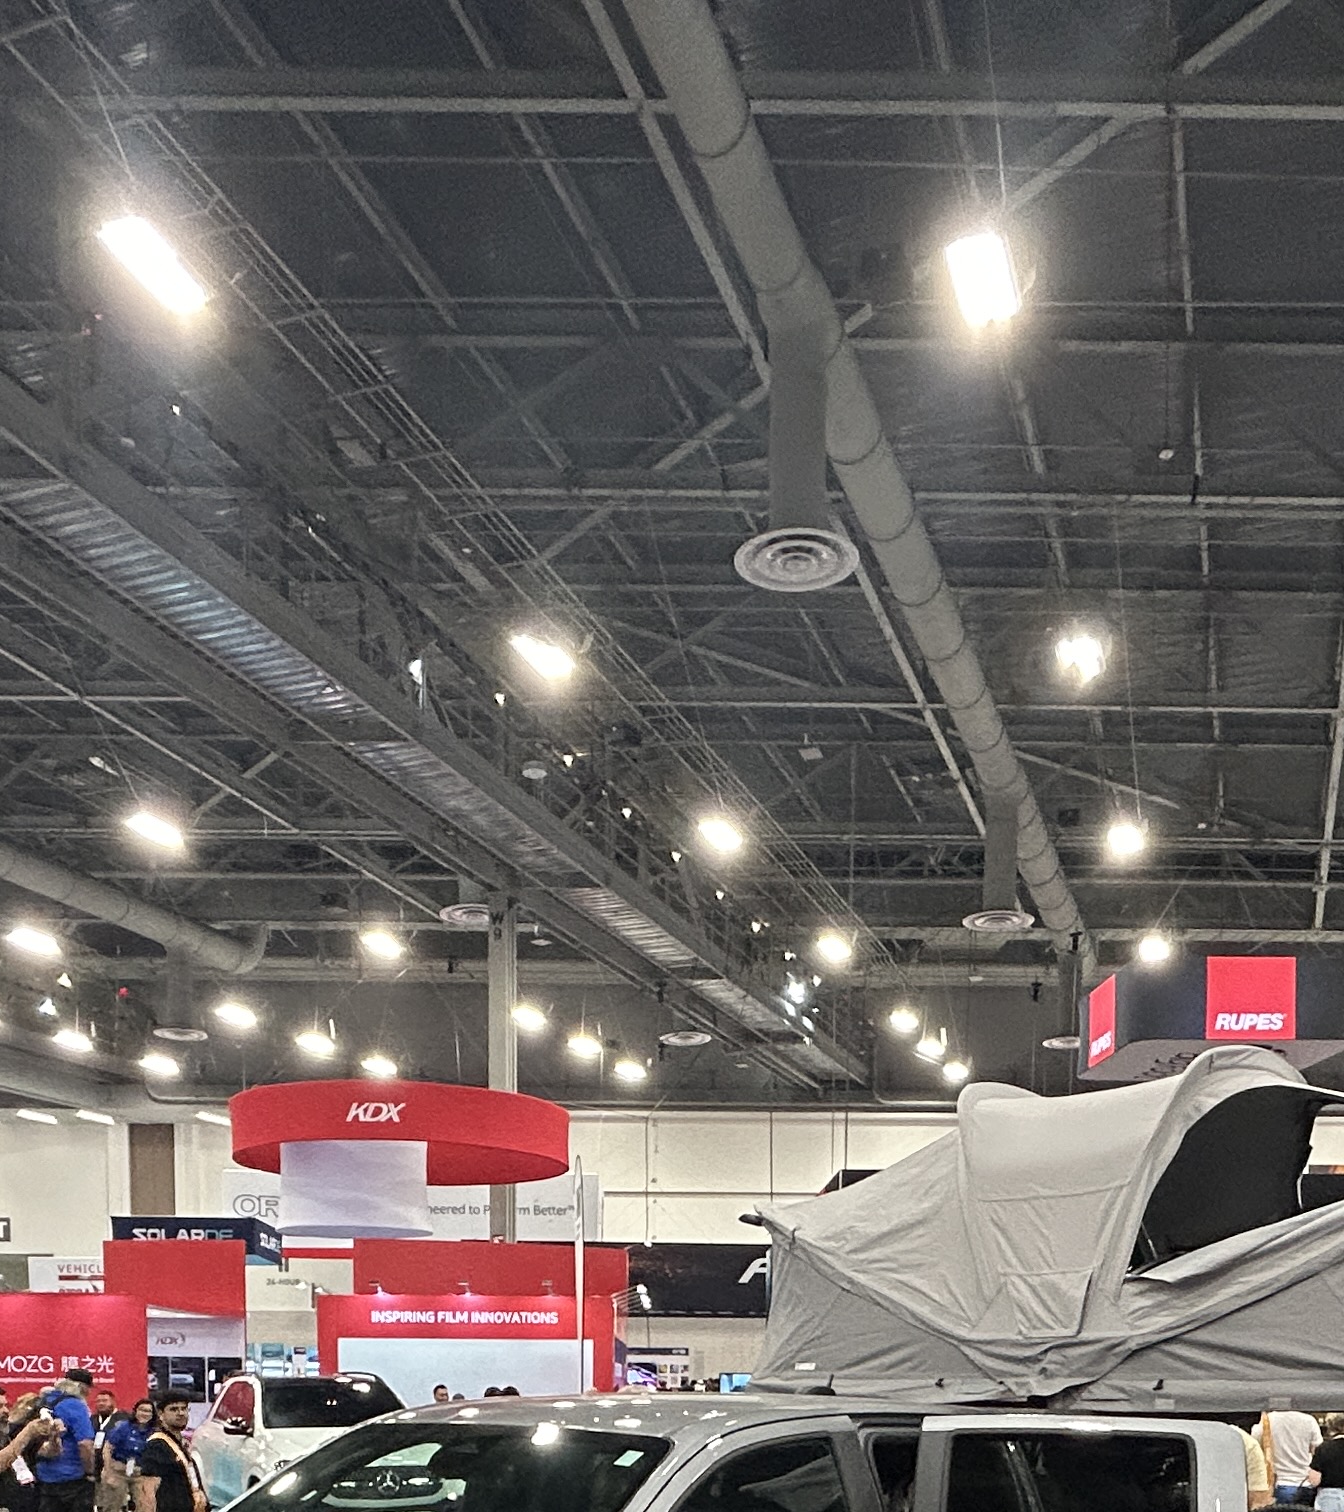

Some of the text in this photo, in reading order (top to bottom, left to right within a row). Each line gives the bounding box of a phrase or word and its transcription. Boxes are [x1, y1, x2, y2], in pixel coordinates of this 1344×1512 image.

[1215, 1013, 1286, 1031] RUPES
[346, 1102, 405, 1123] KDX
[371, 1310, 558, 1325] INSPIRING FILM INNOVATIONS
